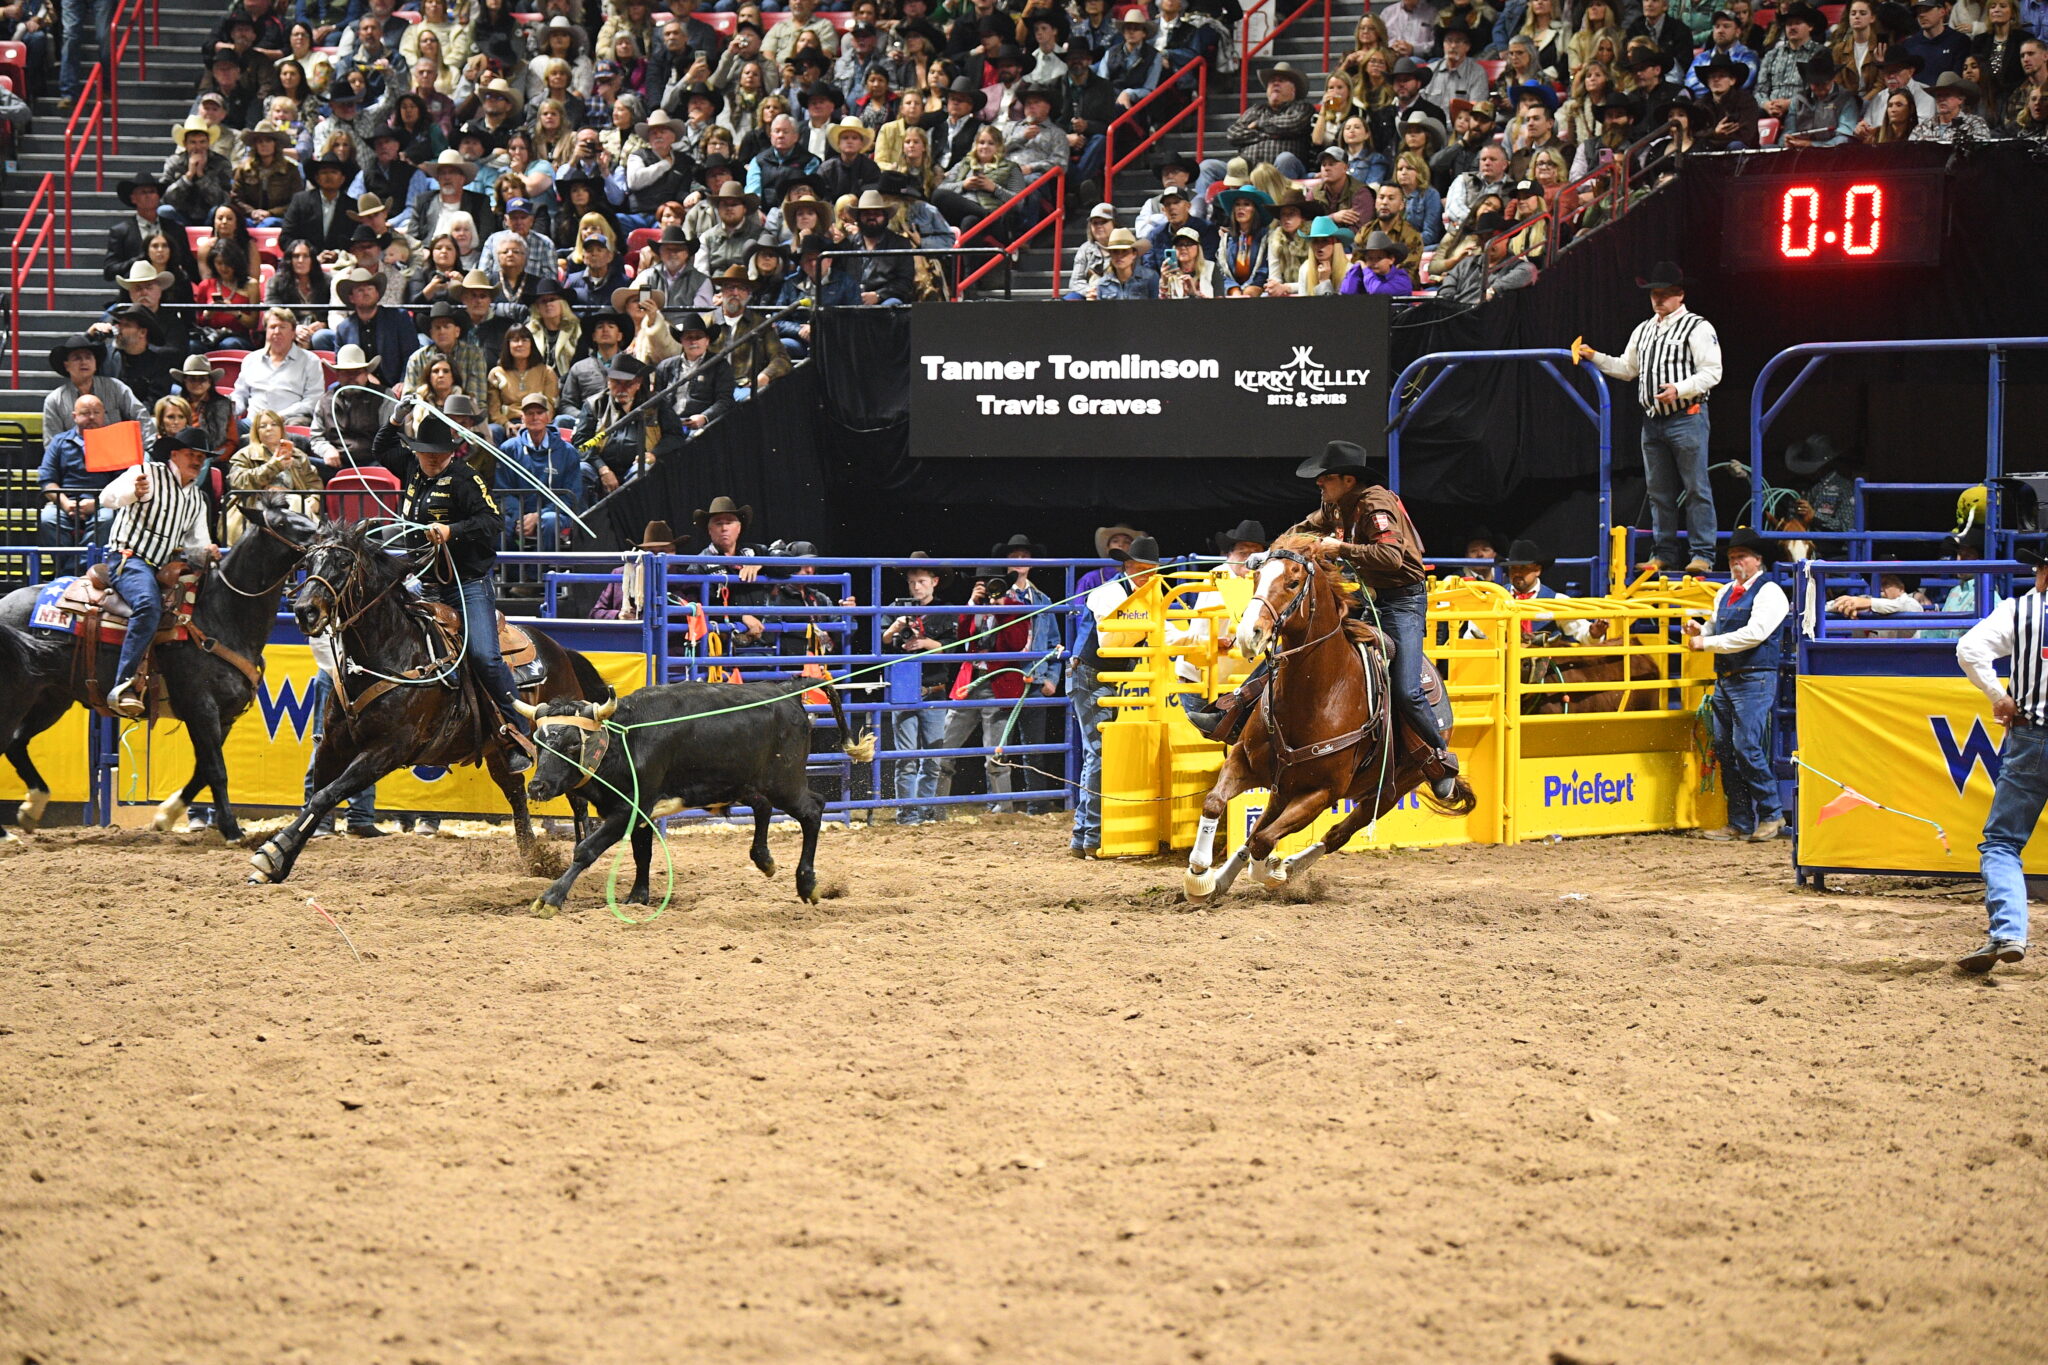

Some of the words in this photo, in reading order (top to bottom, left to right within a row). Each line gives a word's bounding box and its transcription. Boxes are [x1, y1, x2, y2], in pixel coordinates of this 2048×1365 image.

[1781, 185, 1881, 257] 0.0
[921, 355, 1041, 380] Tanner
[1048, 354, 1219, 380] Tomlinson
[1234, 370, 1298, 393] KERRY
[1300, 369, 1370, 392] KELLEY
[976, 394, 1060, 415] Travis
[1068, 394, 1161, 415] Graves
[1267, 394, 1293, 405] BITS
[1295, 392, 1308, 407] &
[1310, 393, 1347, 405] SPURS
[38, 608, 69, 625] NFR
[1116, 609, 1148, 619] Priefert
[1544, 768, 1634, 807] Priefert
